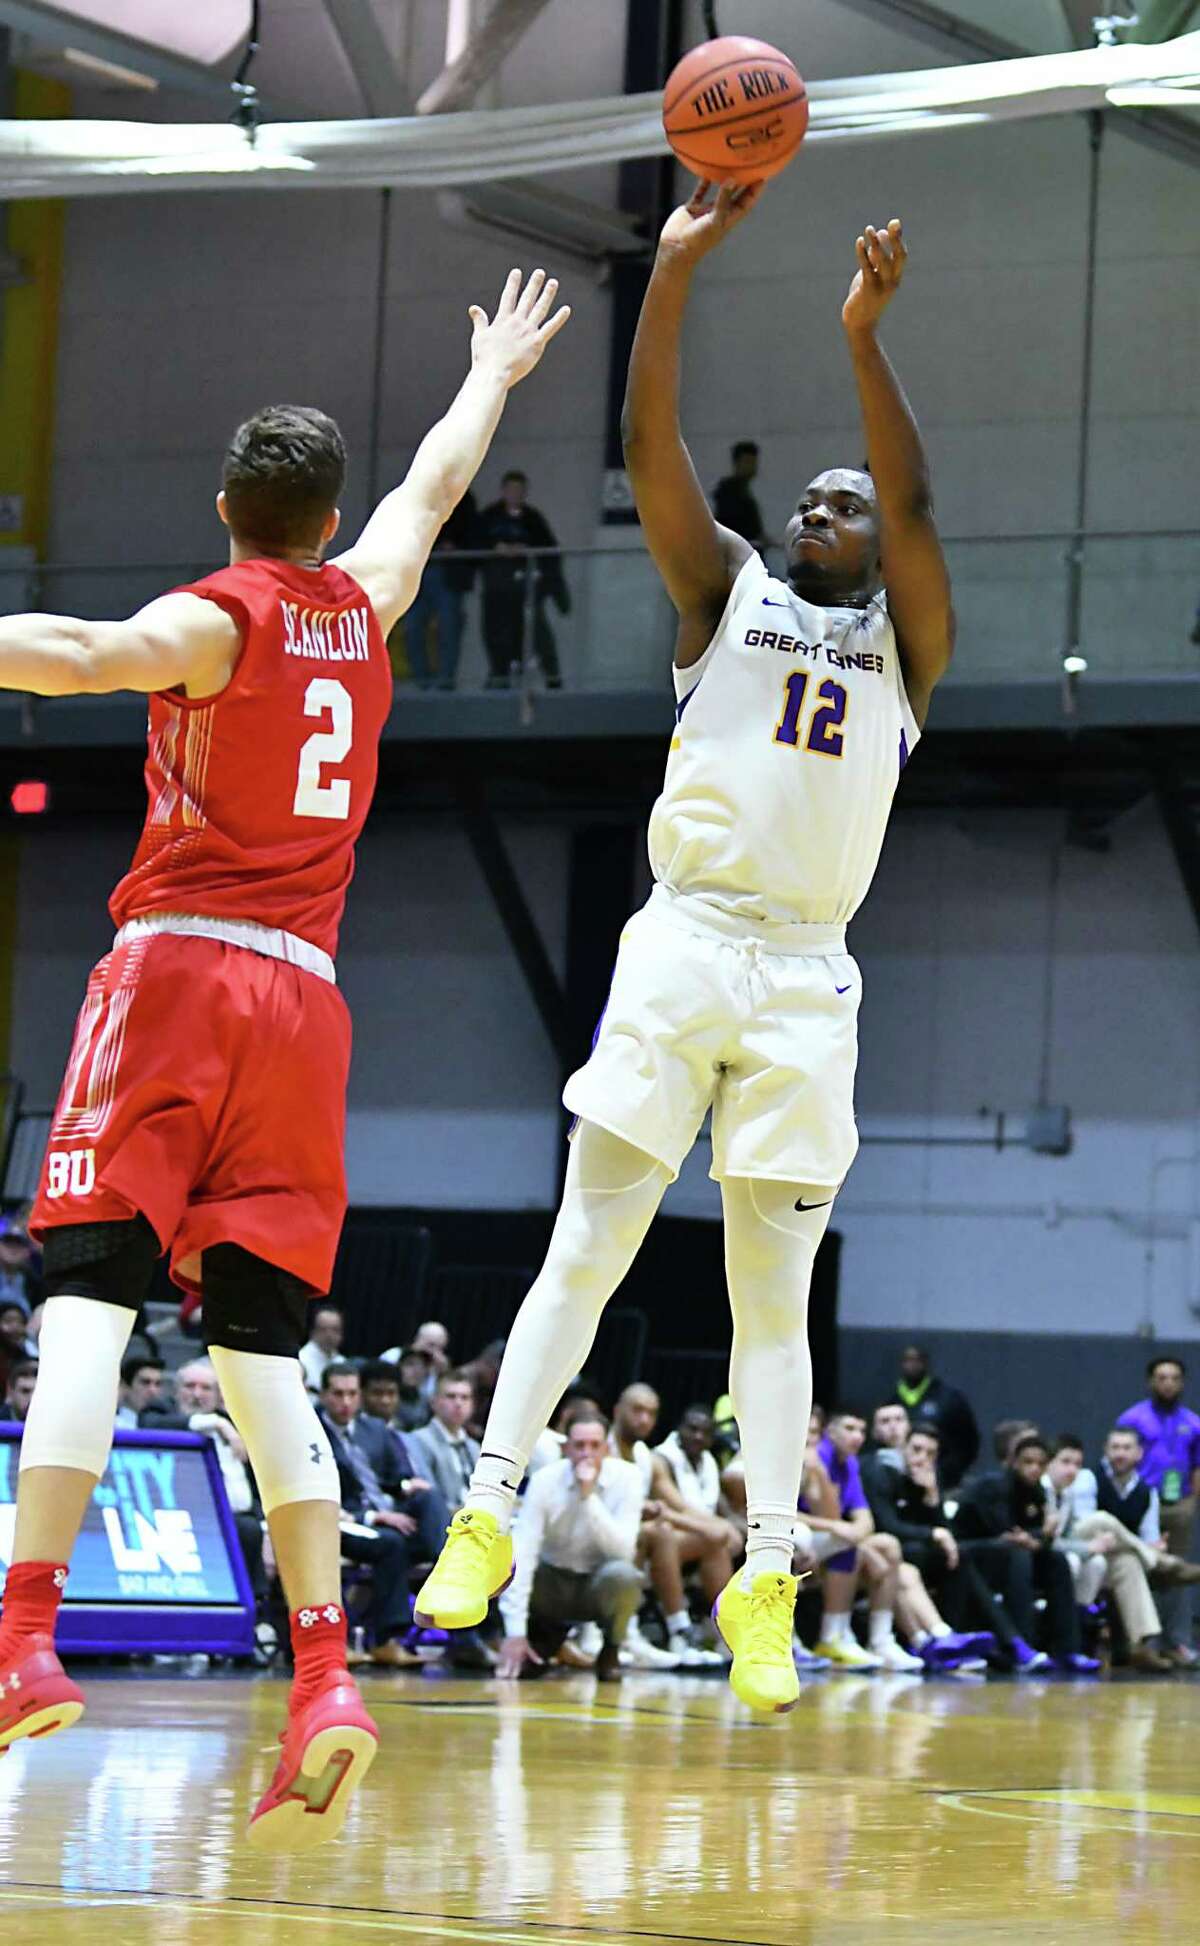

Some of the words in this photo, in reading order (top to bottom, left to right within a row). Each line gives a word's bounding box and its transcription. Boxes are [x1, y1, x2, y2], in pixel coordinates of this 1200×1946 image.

[692, 78, 735, 117] THE
[738, 70, 789, 101] ROCK
[280, 599, 369, 661] SCANLON
[744, 629, 823, 661] GREAT
[773, 668, 848, 760] 12
[293, 677, 353, 820] 2
[46, 1148, 96, 1199] BU
